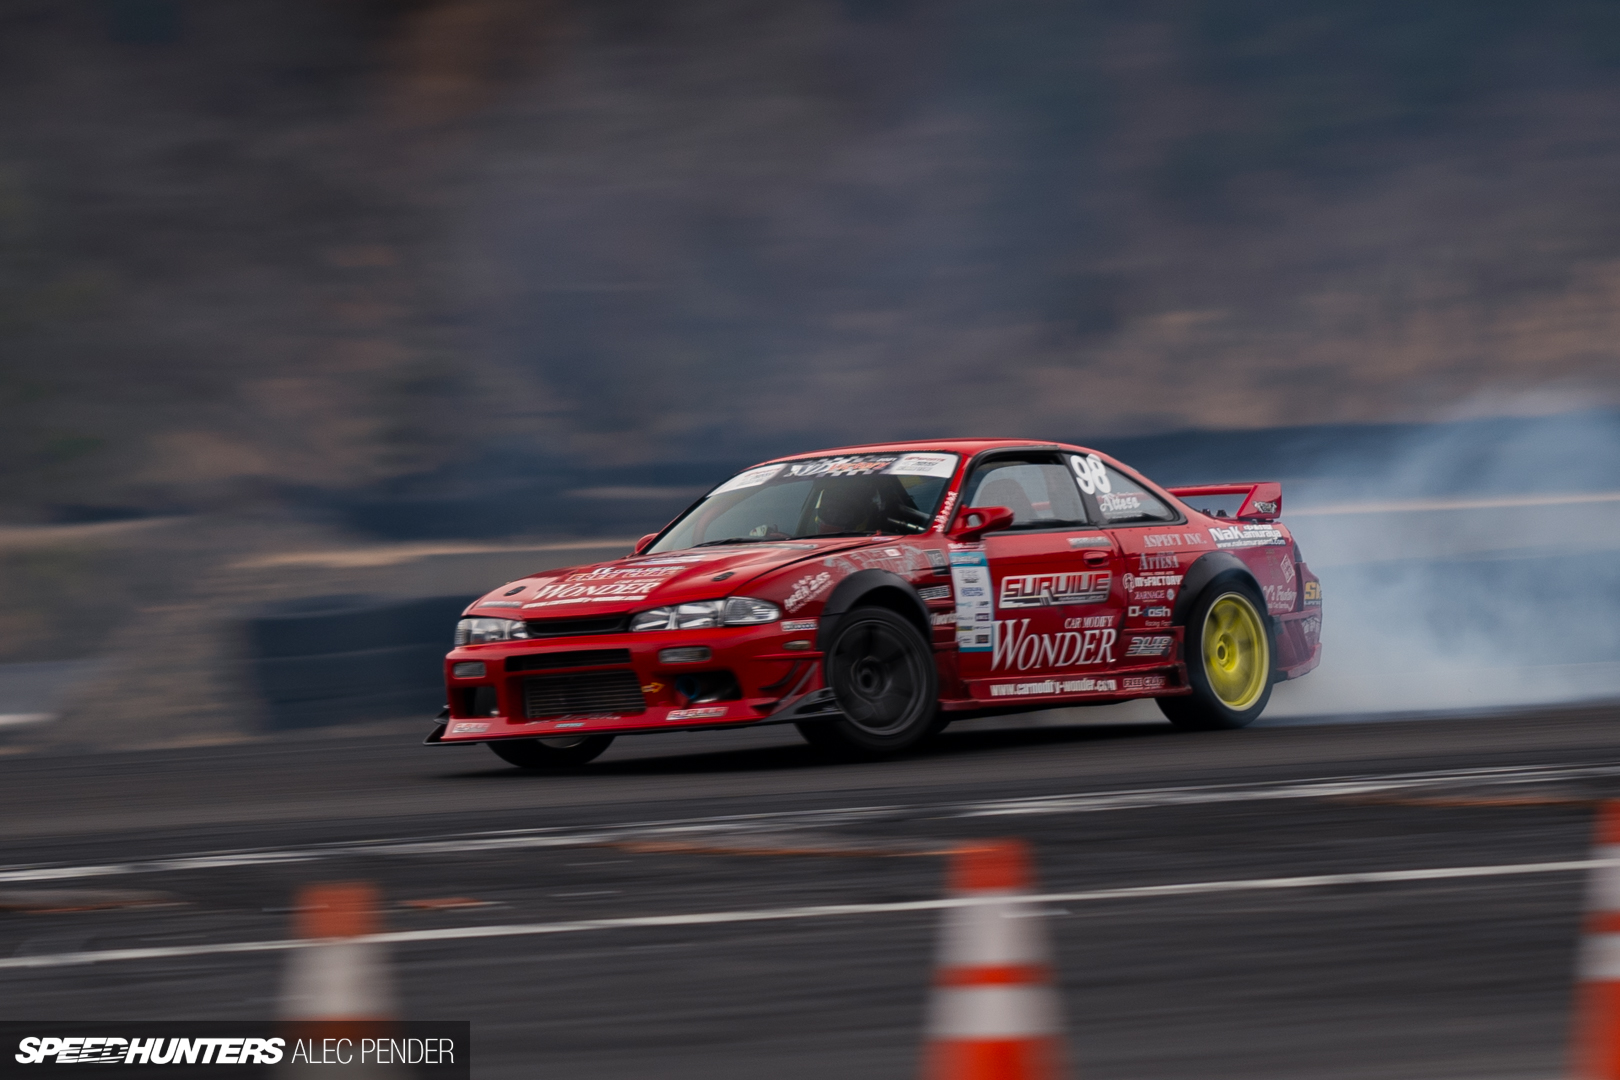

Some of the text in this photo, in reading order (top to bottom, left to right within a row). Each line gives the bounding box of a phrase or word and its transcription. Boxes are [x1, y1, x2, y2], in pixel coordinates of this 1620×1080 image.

[1070, 453, 1111, 495] 98
[1143, 533, 1182, 548] ASPECT
[1138, 553, 1179, 570] ATTESA
[533, 582, 661, 601] WONDER
[1002, 572, 1111, 606] SURVIVE
[1064, 615, 1115, 629] CAR MODIFY
[991, 618, 1117, 671] WONDER
